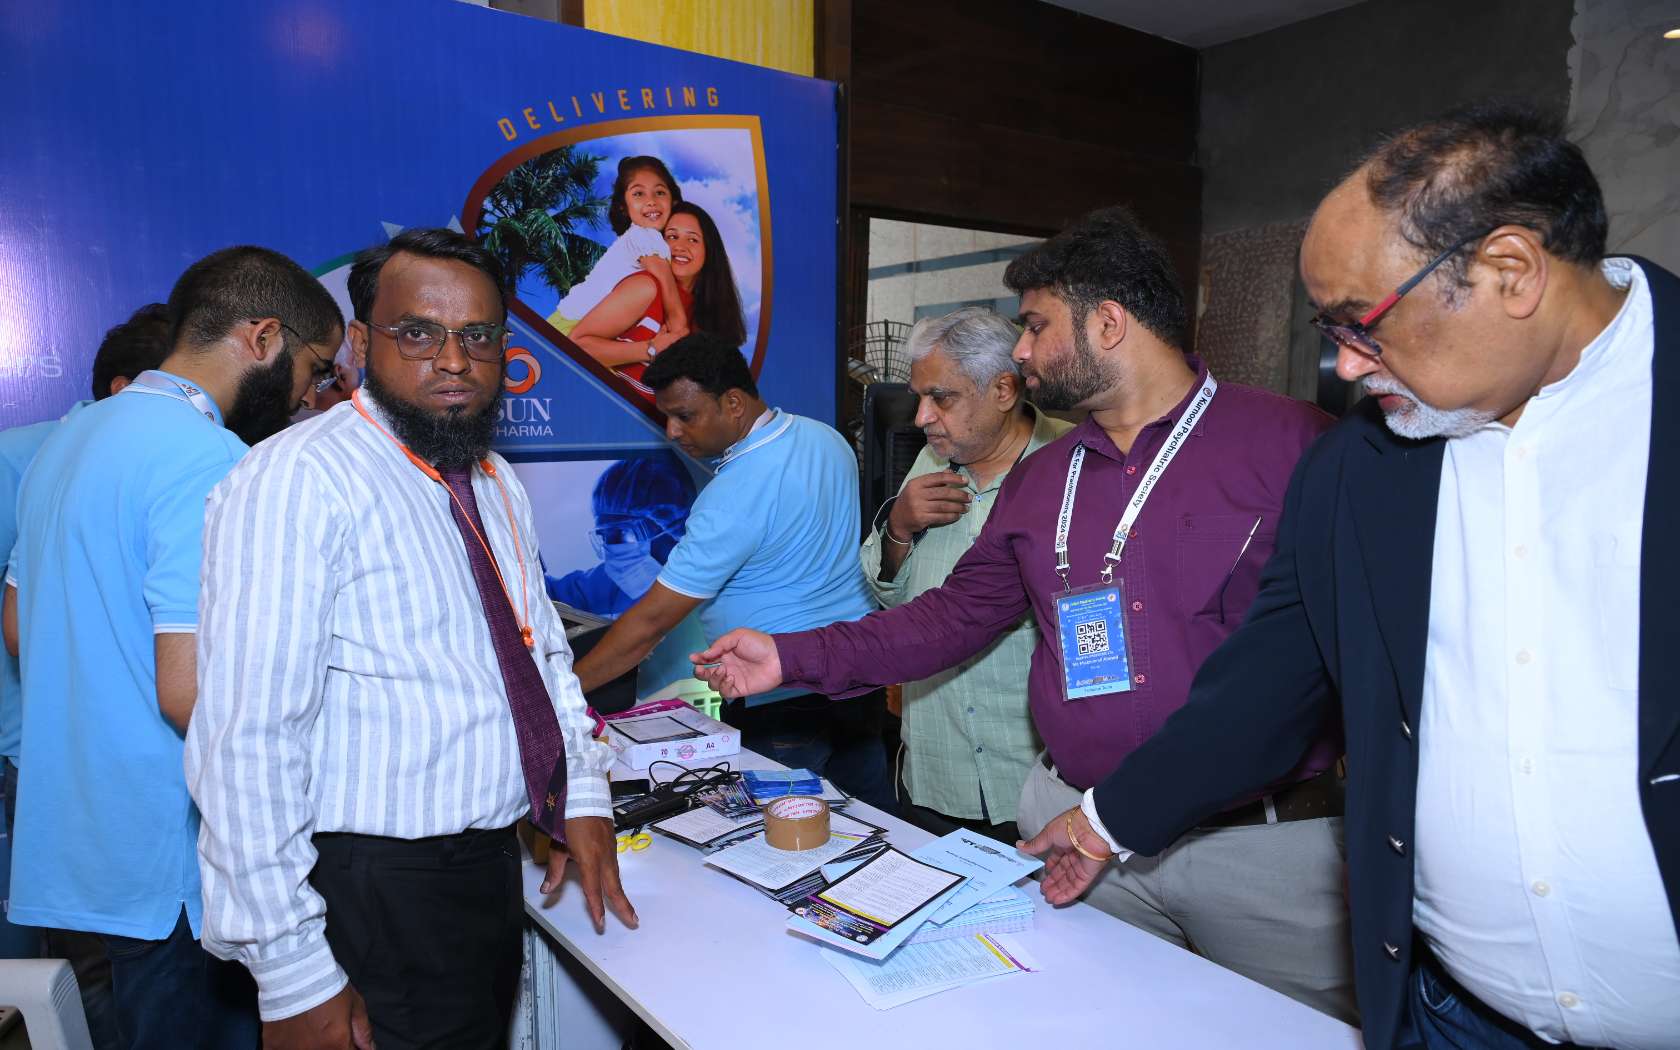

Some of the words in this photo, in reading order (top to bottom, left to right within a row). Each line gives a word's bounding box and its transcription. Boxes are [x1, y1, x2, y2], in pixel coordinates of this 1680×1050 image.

[497, 87, 719, 141] DELIVERING
[1184, 397, 1208, 427] Kurnool
[1153, 426, 1189, 473] Psychiatric
[1132, 474, 1157, 508] Society
